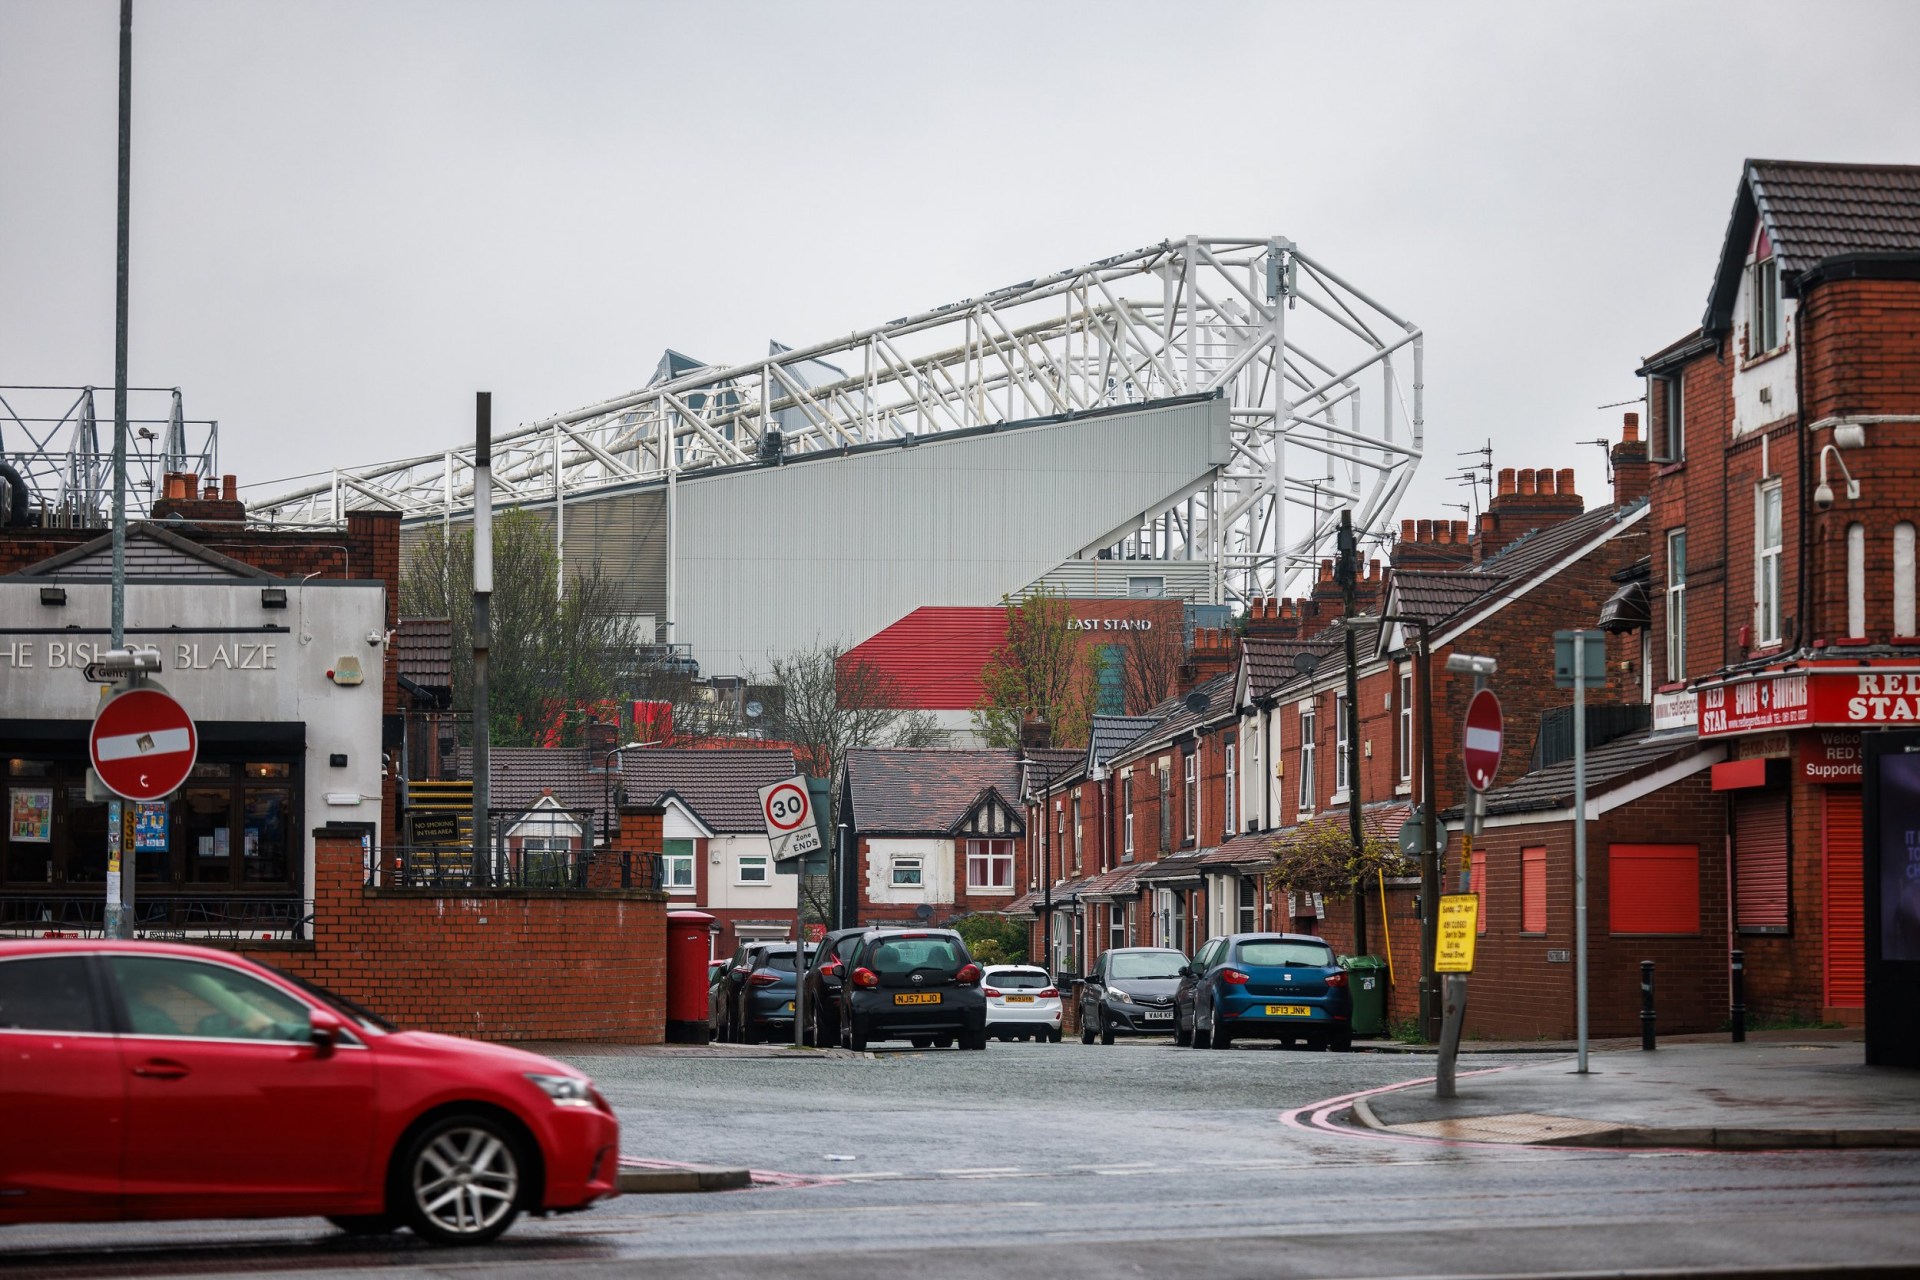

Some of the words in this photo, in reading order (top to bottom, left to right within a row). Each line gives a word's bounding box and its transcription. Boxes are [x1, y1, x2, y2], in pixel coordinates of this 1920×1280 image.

[1067, 618, 1100, 630] EAST
[1103, 619, 1152, 630] STAND
[174, 643, 278, 670] BLAIZE
[1706, 687, 1725, 709] RED
[1735, 681, 1759, 715] SPORTS
[1848, 697, 1920, 720] STA
[1703, 709, 1728, 733] STAR
[1821, 732, 1860, 745] Welco
[1826, 747, 1855, 760] RED
[1806, 763, 1863, 778] Supporte
[773, 796, 801, 818] 30
[426, 820, 454, 828] SMOKING
[795, 832, 812, 841] Zone
[792, 838, 818, 852] ENDS
[897, 994, 920, 1004] NJ57
[1270, 1006, 1289, 1014] DF13
[1290, 1006, 1306, 1015] JNK
